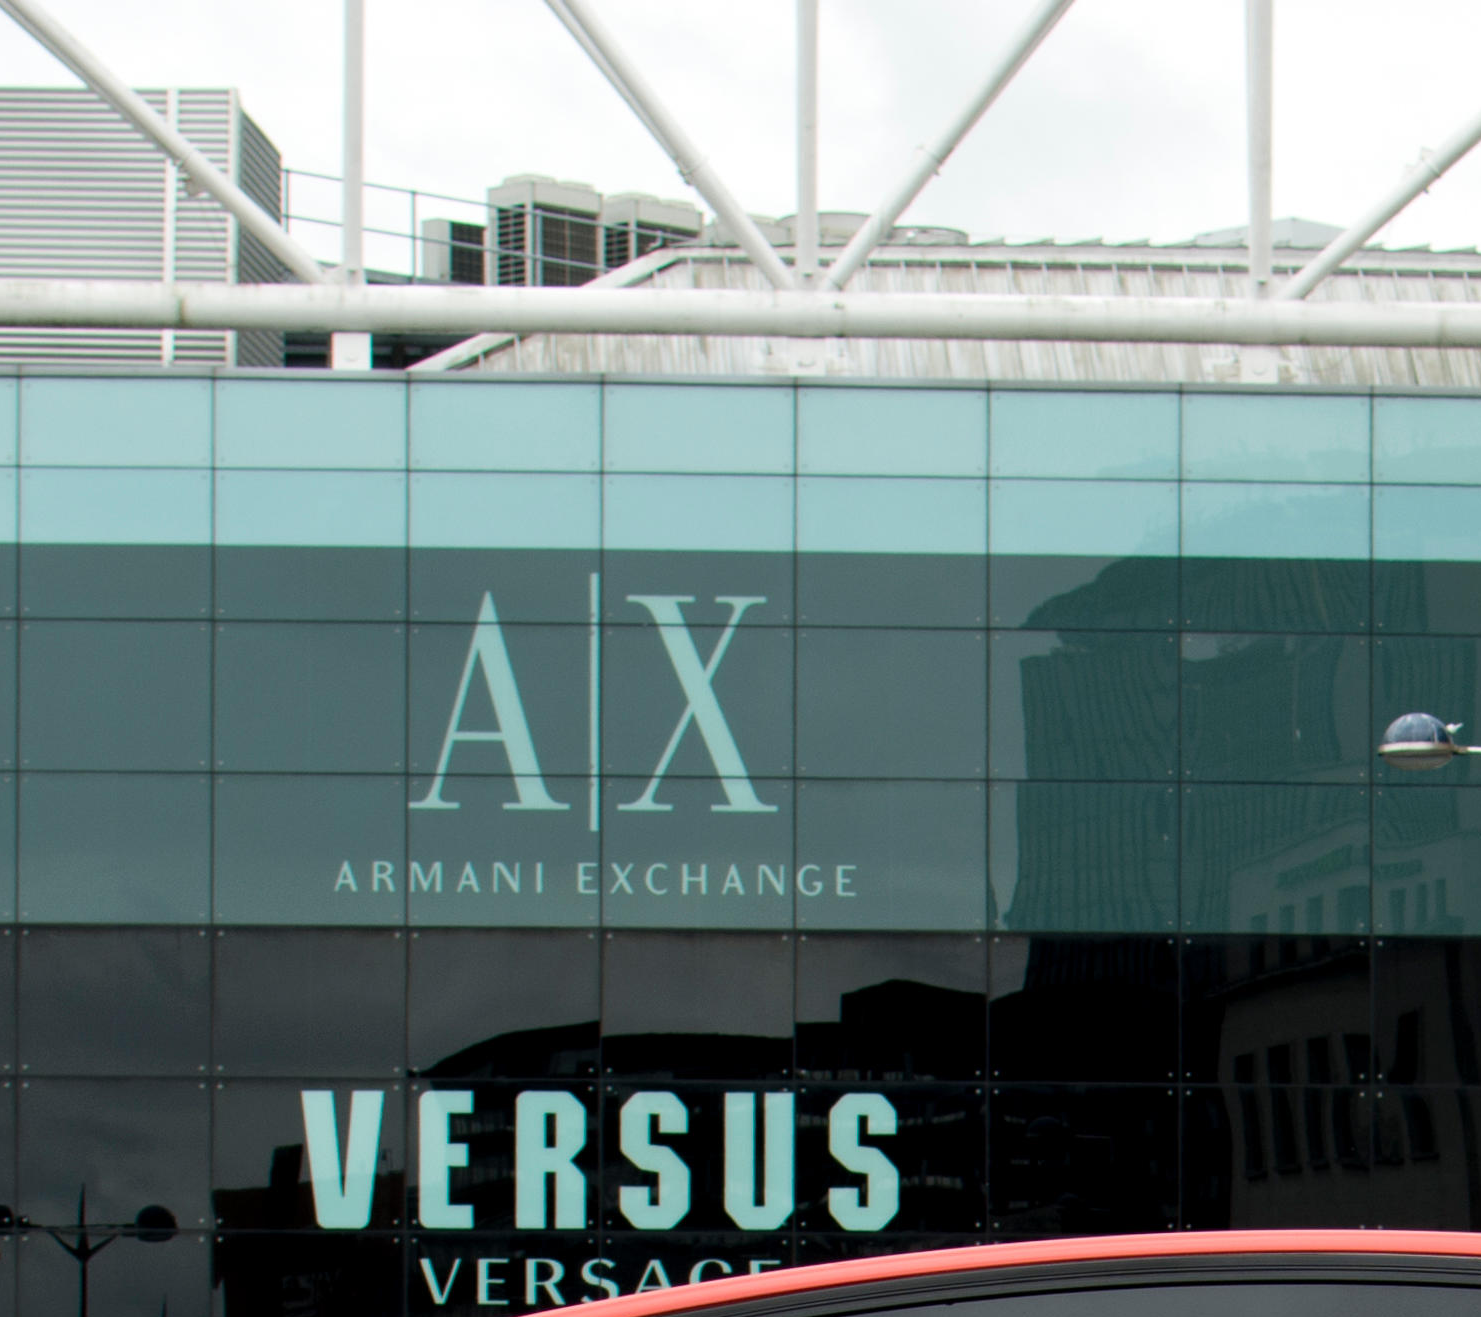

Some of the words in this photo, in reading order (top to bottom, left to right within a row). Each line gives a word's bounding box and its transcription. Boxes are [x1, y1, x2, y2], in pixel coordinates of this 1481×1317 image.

[333, 859, 545, 893] ARMANI
[575, 863, 859, 898] EXCHANGE
[300, 1089, 901, 1232] VERSUS
[419, 1257, 783, 1306] VERSA
